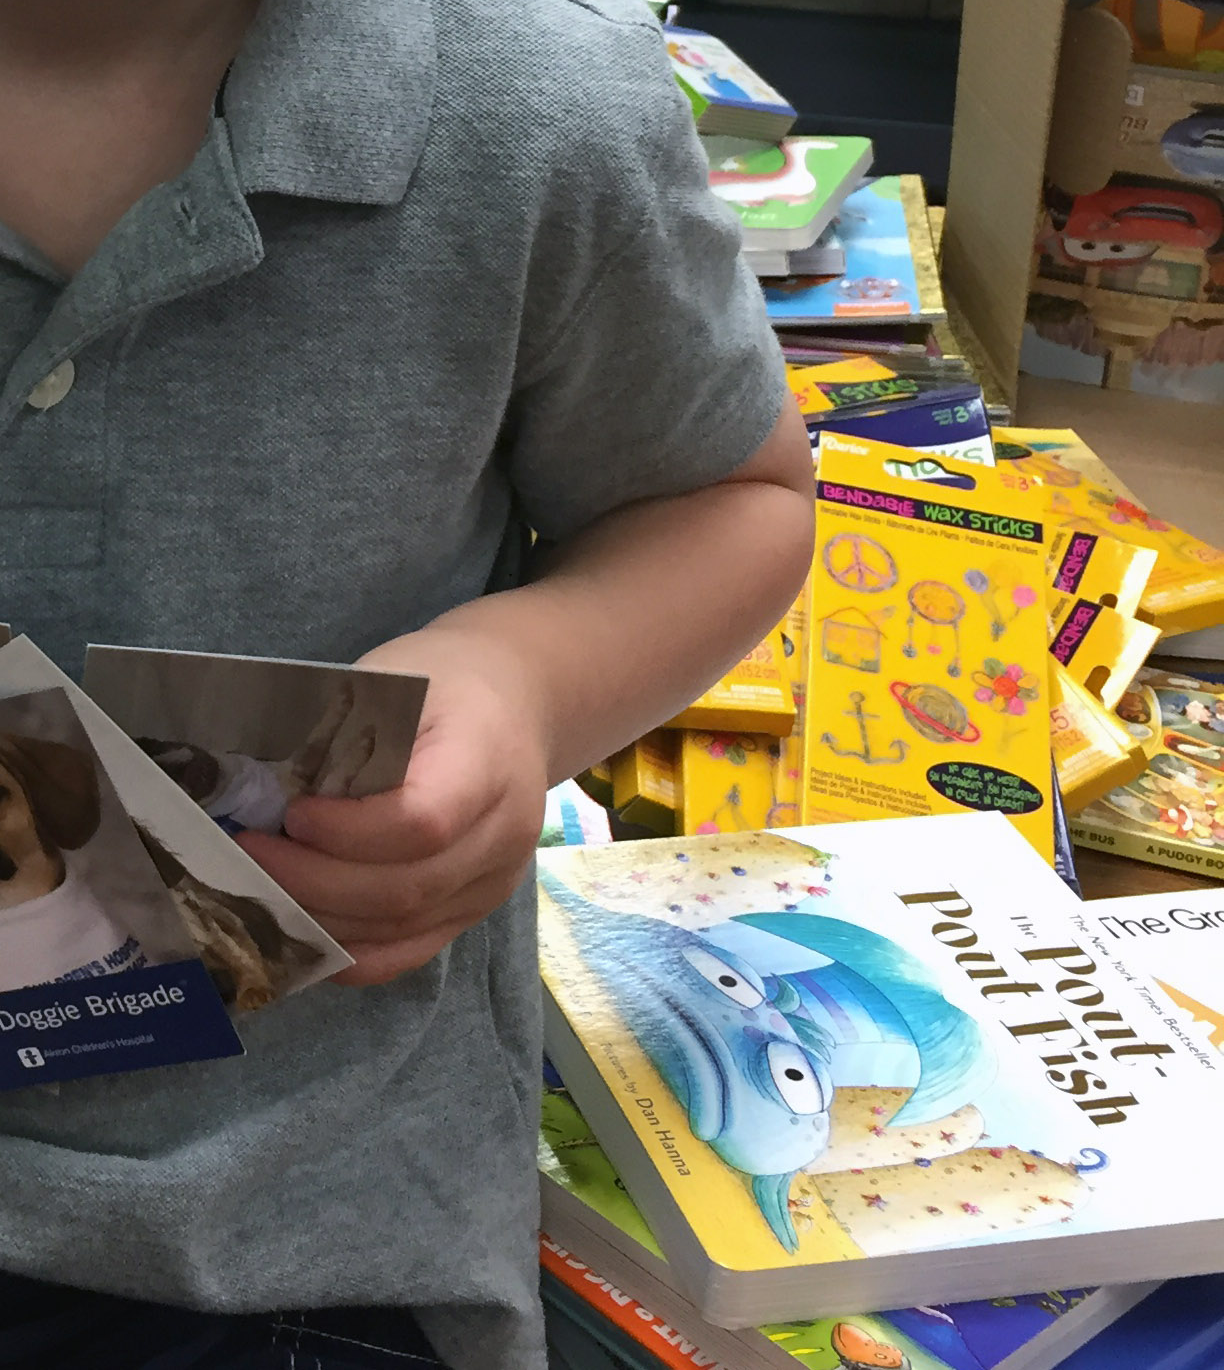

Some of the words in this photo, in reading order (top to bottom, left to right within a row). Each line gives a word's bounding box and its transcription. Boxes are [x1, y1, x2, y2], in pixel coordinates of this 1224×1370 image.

[1089, 831, 1116, 845] BUS
[1146, 845, 1156, 855] A
[1158, 848, 1203, 865] PUDGY
[1206, 857, 1224, 870] BO
[1097, 915, 1172, 939] The
[84, 984, 187, 1017] Brigade
[893, 883, 1045, 1005] Pout
[999, 1011, 1141, 1130] Fish
[1067, 914, 1088, 933] The
[1089, 935, 1111, 957] New
[1111, 959, 1138, 983] York
[1133, 985, 1165, 1017] Times
[1162, 1018, 1217, 1071] Bestseller
[71, 1040, 116, 1055] Children's
[116, 1033, 156, 1047] Hospital
[624, 1079, 638, 1095] by
[635, 1097, 661, 1128] Dan
[655, 1129, 691, 1177] Hanna
